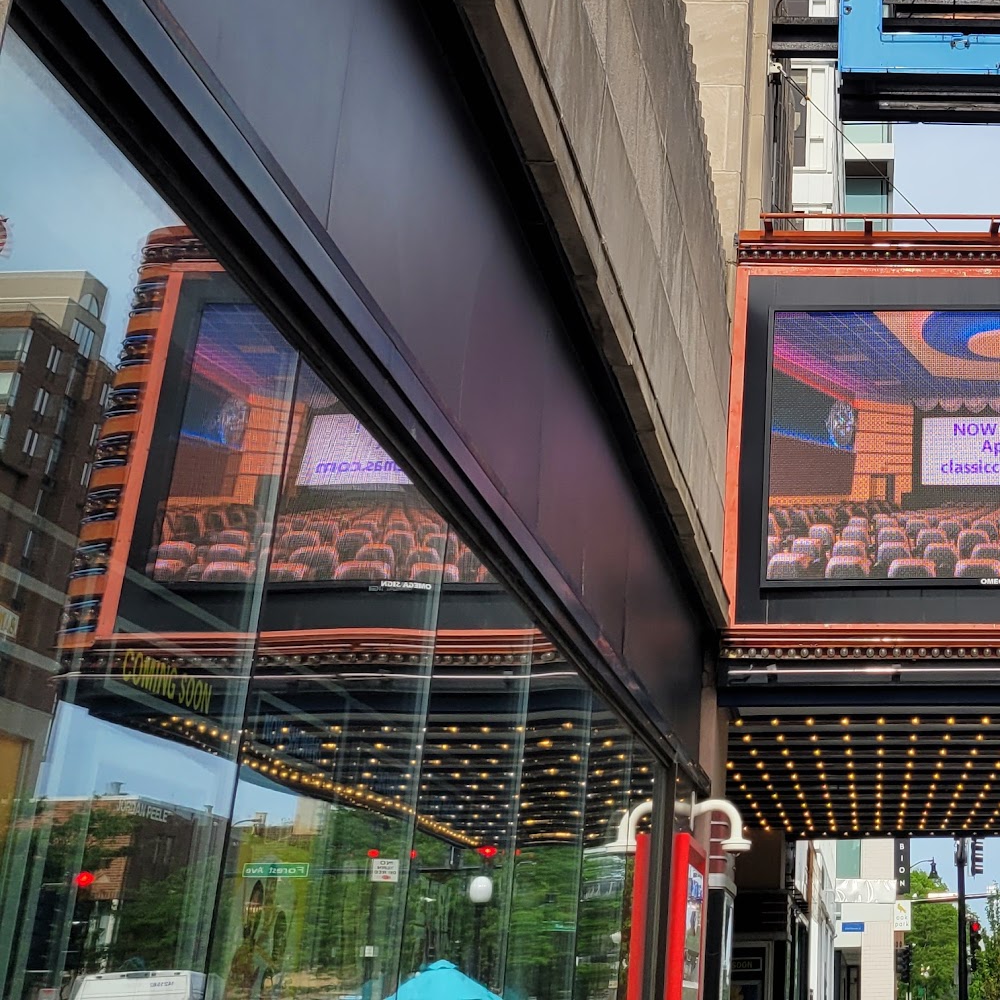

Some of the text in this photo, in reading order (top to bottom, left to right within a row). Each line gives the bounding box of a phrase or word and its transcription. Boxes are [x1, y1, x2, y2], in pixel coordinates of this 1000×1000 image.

[953, 422, 997, 436] NOW
[123, 648, 213, 715] COMING SOON
[116, 799, 169, 823] JORDAN PEELE
[731, 961, 753, 969] SOON
